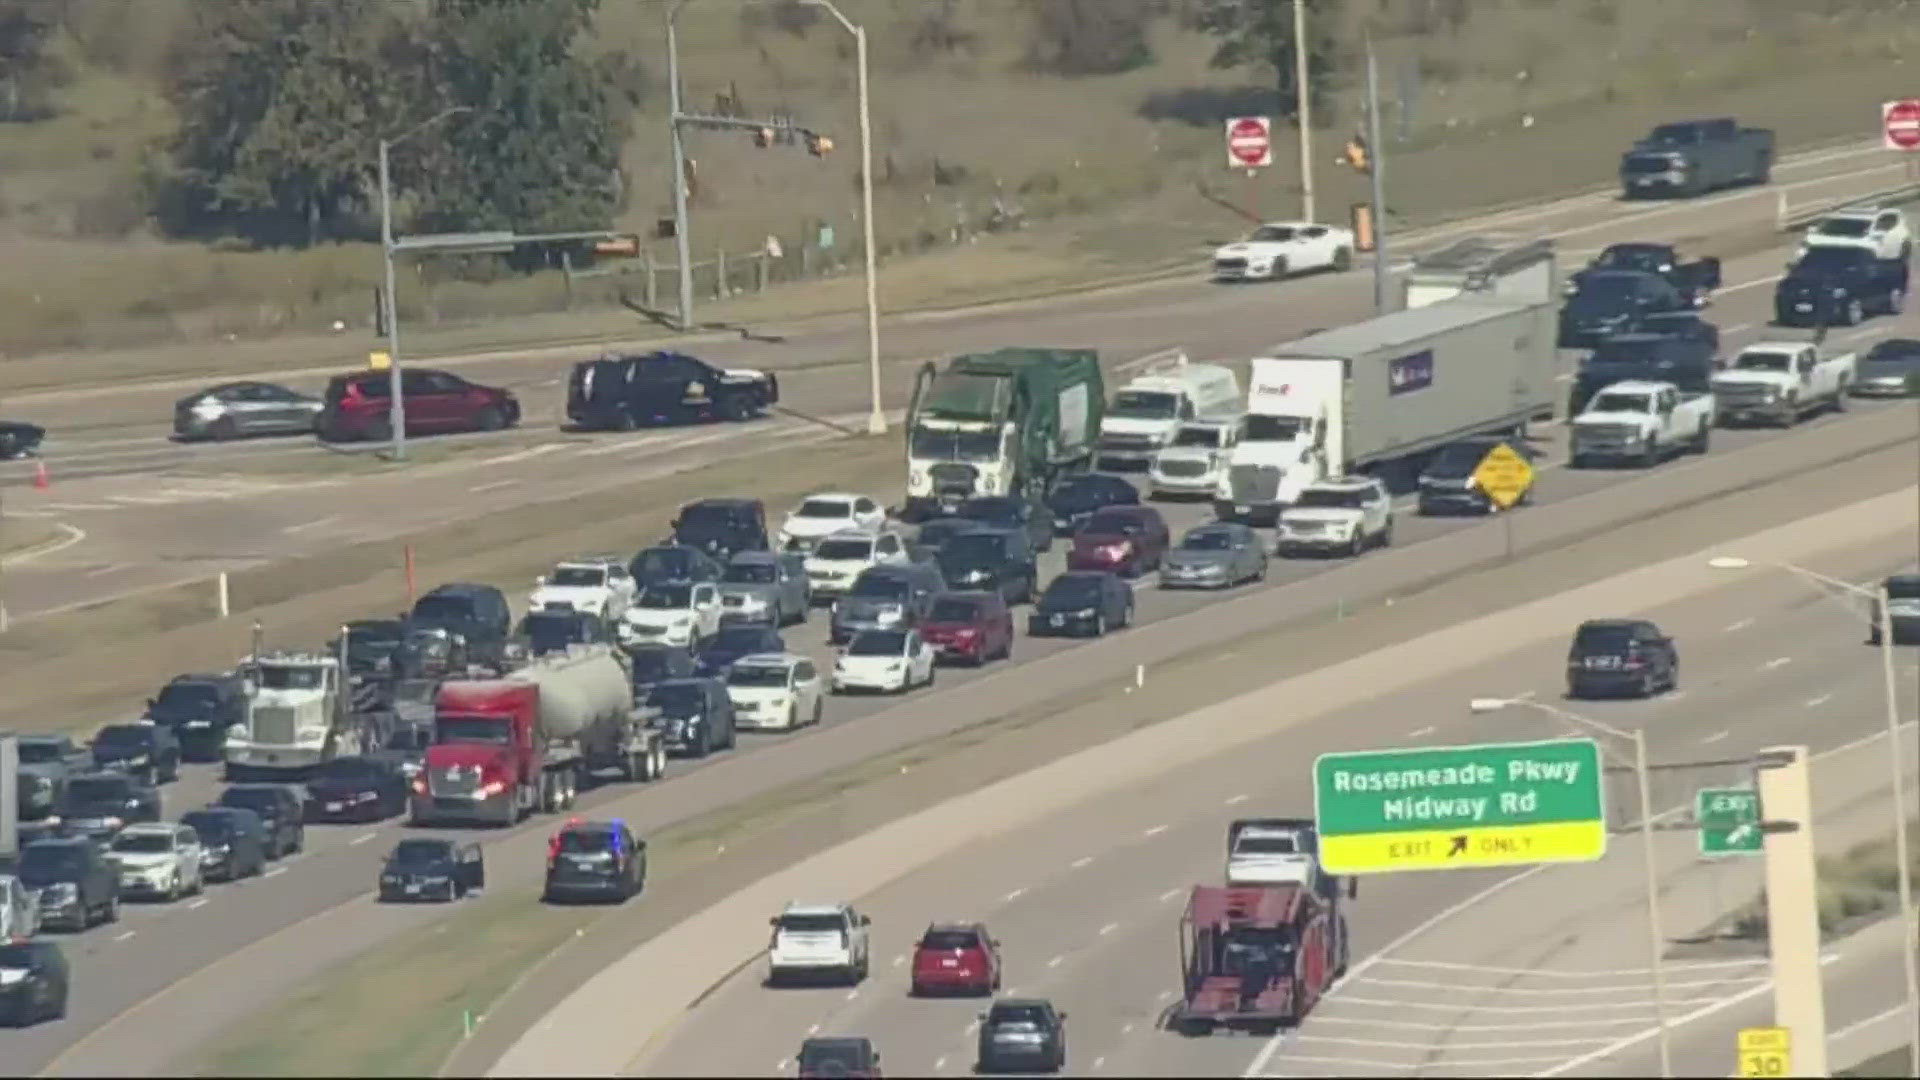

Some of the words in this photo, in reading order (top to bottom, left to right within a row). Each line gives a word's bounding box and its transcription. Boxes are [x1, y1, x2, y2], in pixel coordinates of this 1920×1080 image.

[1334, 763, 1495, 792] Rosemeade
[1508, 760, 1579, 784] Pkwy
[1383, 796, 1487, 820] Midway
[1500, 790, 1536, 814] Rd
[1388, 841, 1432, 858] EXIT
[1480, 837, 1533, 853] ONLY
